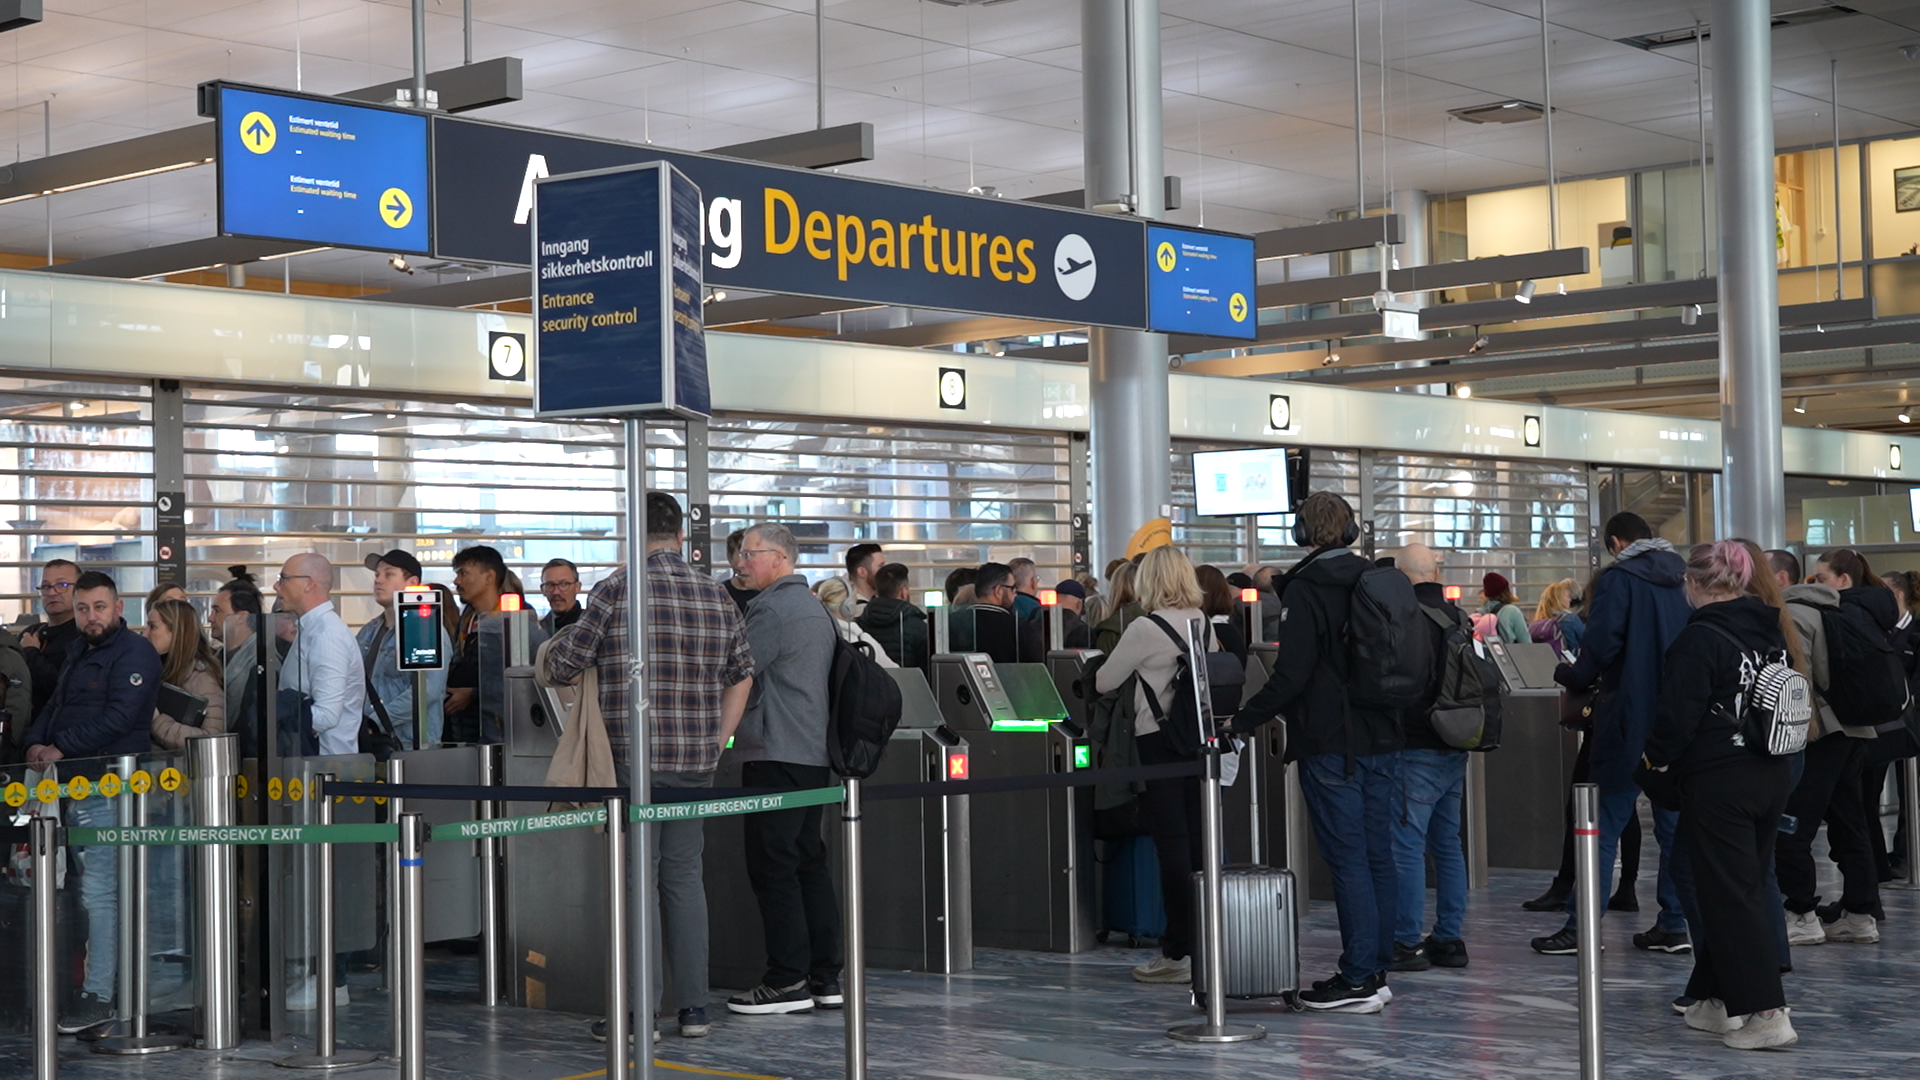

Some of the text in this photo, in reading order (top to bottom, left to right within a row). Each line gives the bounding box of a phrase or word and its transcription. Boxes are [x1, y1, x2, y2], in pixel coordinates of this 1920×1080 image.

[763, 187, 1037, 284] Departures
[541, 238, 589, 259] Inngang
[541, 250, 653, 280] sikkerhetskontroll
[542, 292, 595, 309] Entrance
[542, 307, 638, 332] security control
[503, 345, 511, 363] 7
[638, 796, 783, 819] NO ENTRY / EMERGENCY EXIT
[97, 828, 303, 842] NO ENTRY / EMERGENCY EXIT
[461, 824, 479, 836] NO
[481, 820, 519, 835] ENTRY
[521, 819, 525, 830] /
[527, 811, 595, 830] EMERGENCY
